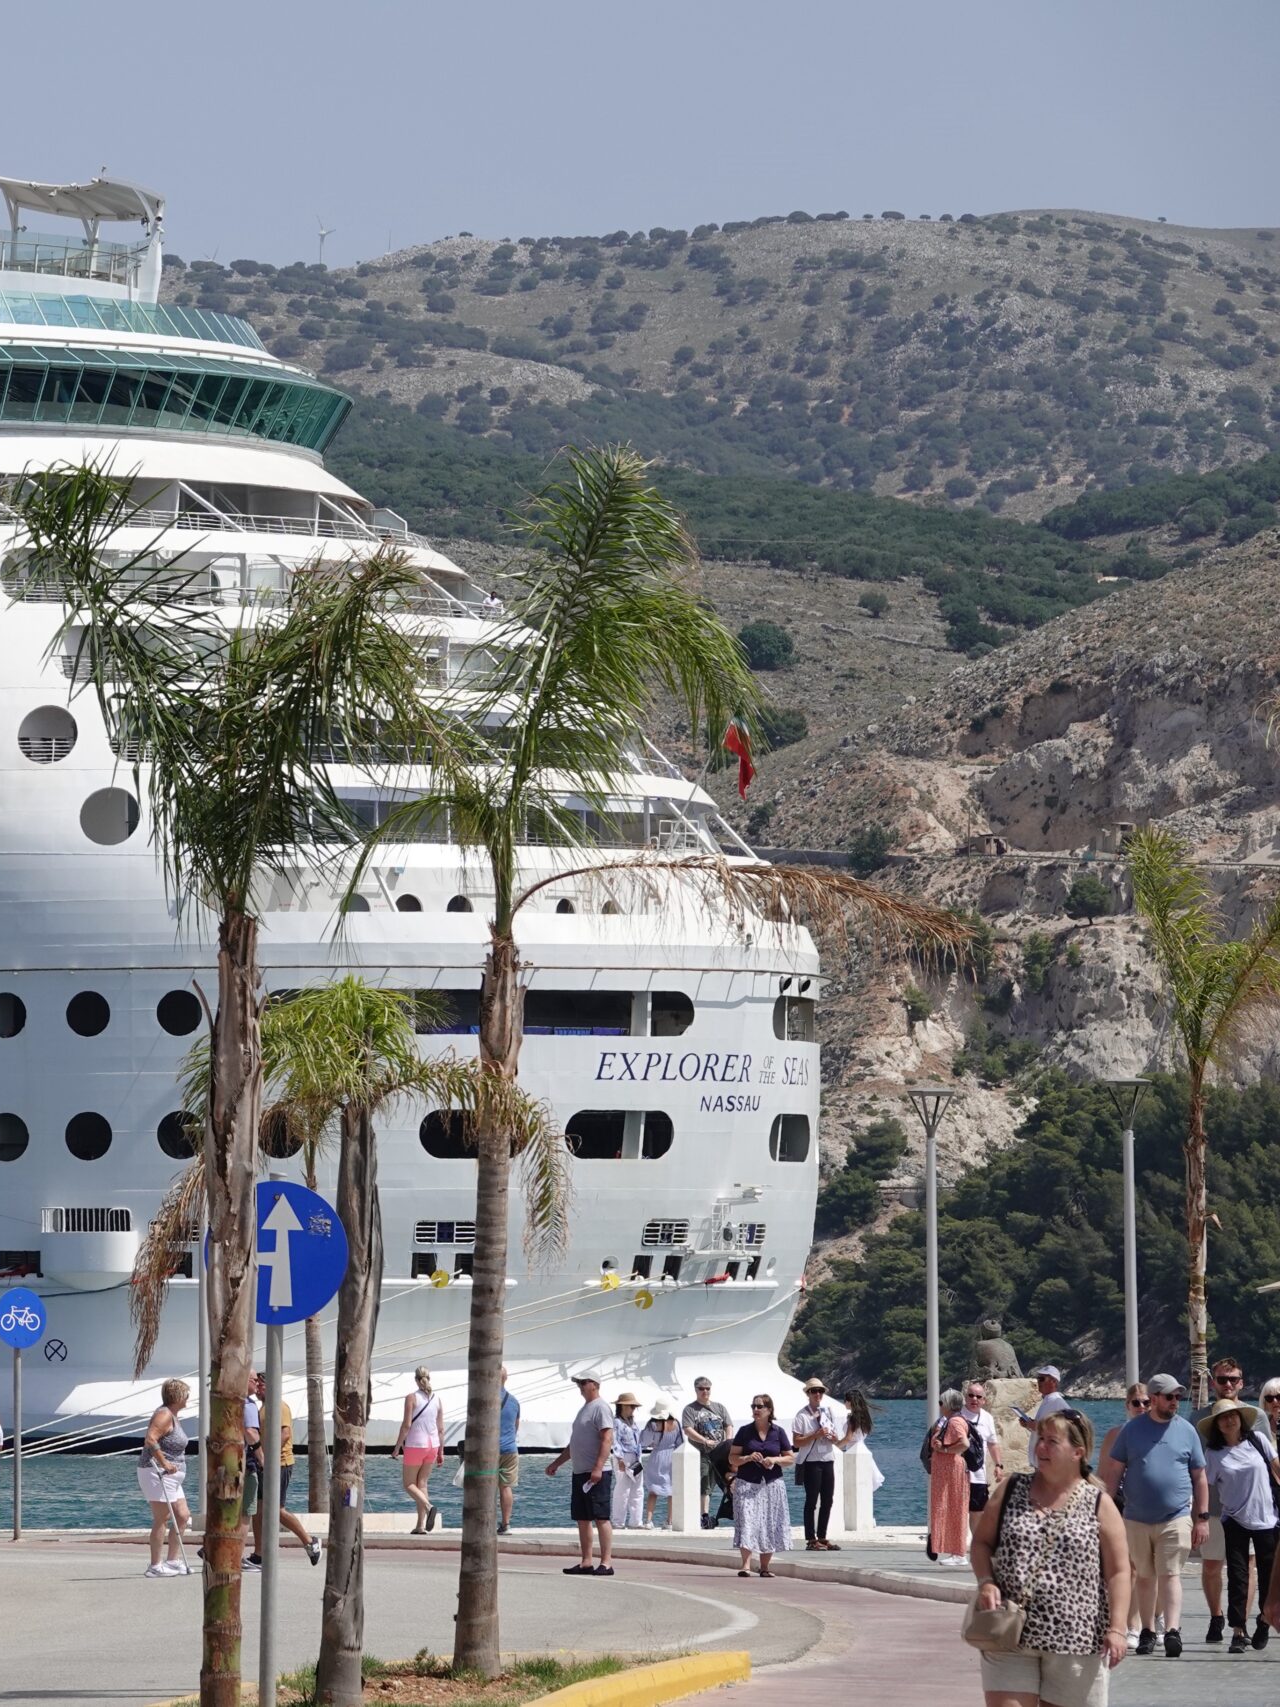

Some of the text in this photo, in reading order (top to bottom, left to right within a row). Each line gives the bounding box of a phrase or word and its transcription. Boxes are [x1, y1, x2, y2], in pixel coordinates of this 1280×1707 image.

[595, 1052, 809, 1085] EXPLORER OF THE SEAS
[700, 1096, 761, 1111] NASSAU
